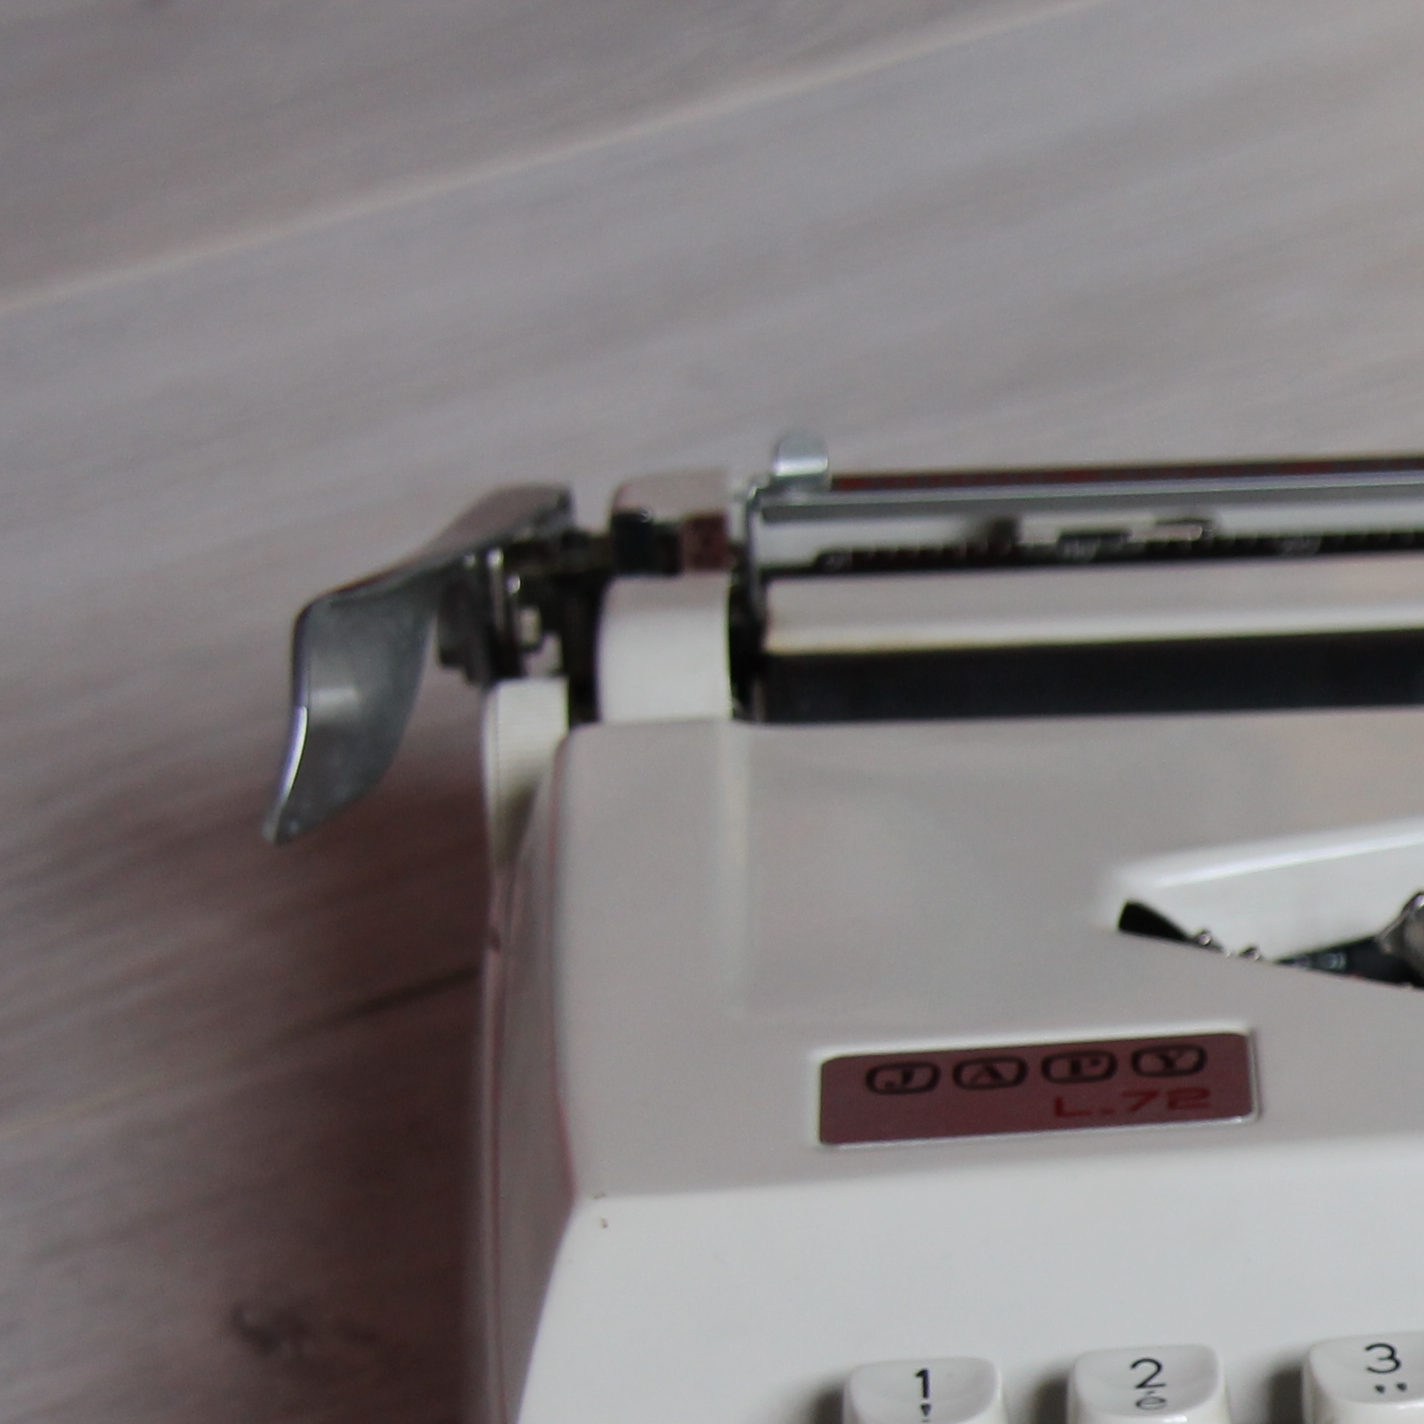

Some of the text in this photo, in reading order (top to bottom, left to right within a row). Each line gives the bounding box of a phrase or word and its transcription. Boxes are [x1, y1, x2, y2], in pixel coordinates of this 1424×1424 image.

[866, 1042, 1209, 1096] JAPY
[1130, 1357, 1167, 1389] 2
[1364, 1343, 1402, 1374] 3
[914, 1368, 931, 1399] 1
